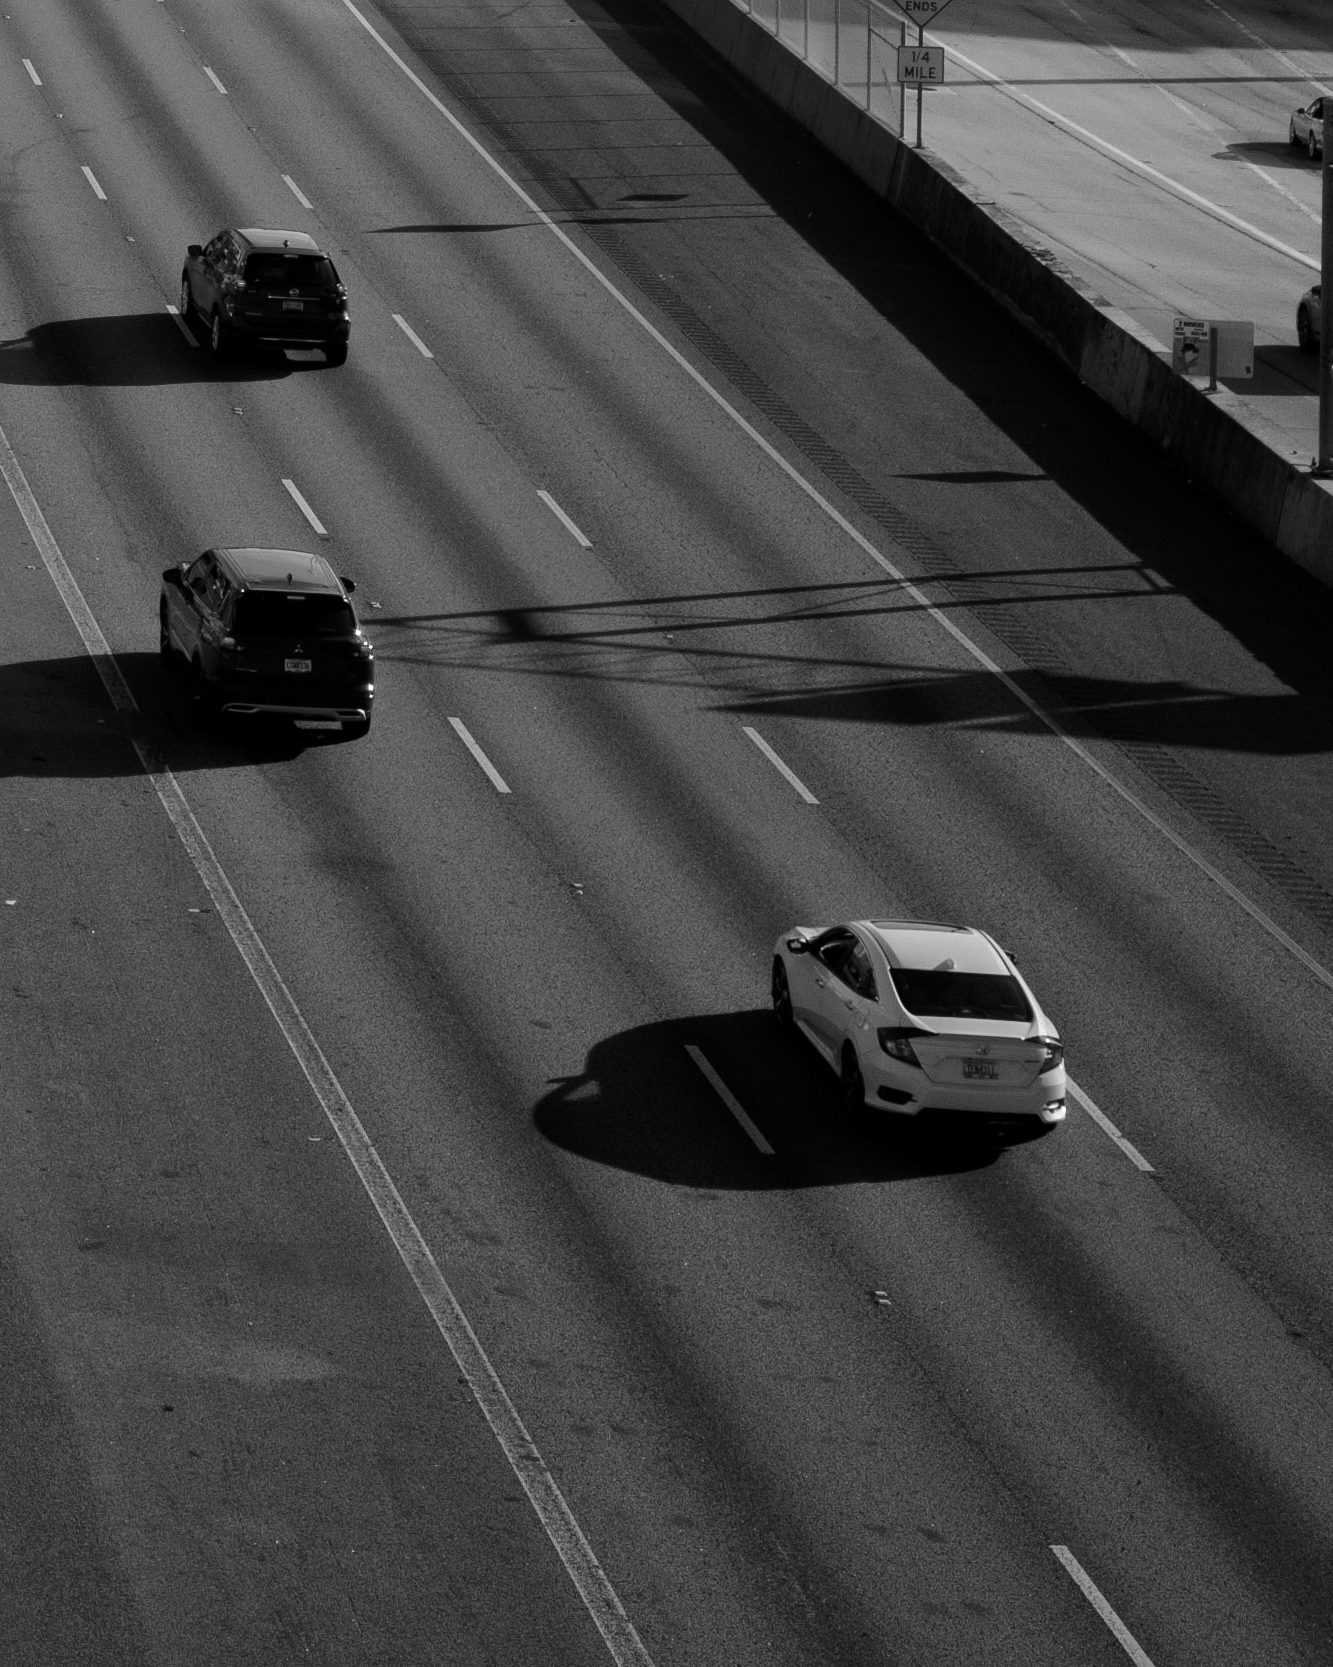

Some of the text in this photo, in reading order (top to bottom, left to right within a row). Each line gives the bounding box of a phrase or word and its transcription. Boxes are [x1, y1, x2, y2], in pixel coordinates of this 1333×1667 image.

[905, 1, 938, 11] ENDS
[912, 50, 930, 63] 1/4
[904, 67, 937, 79] MILE
